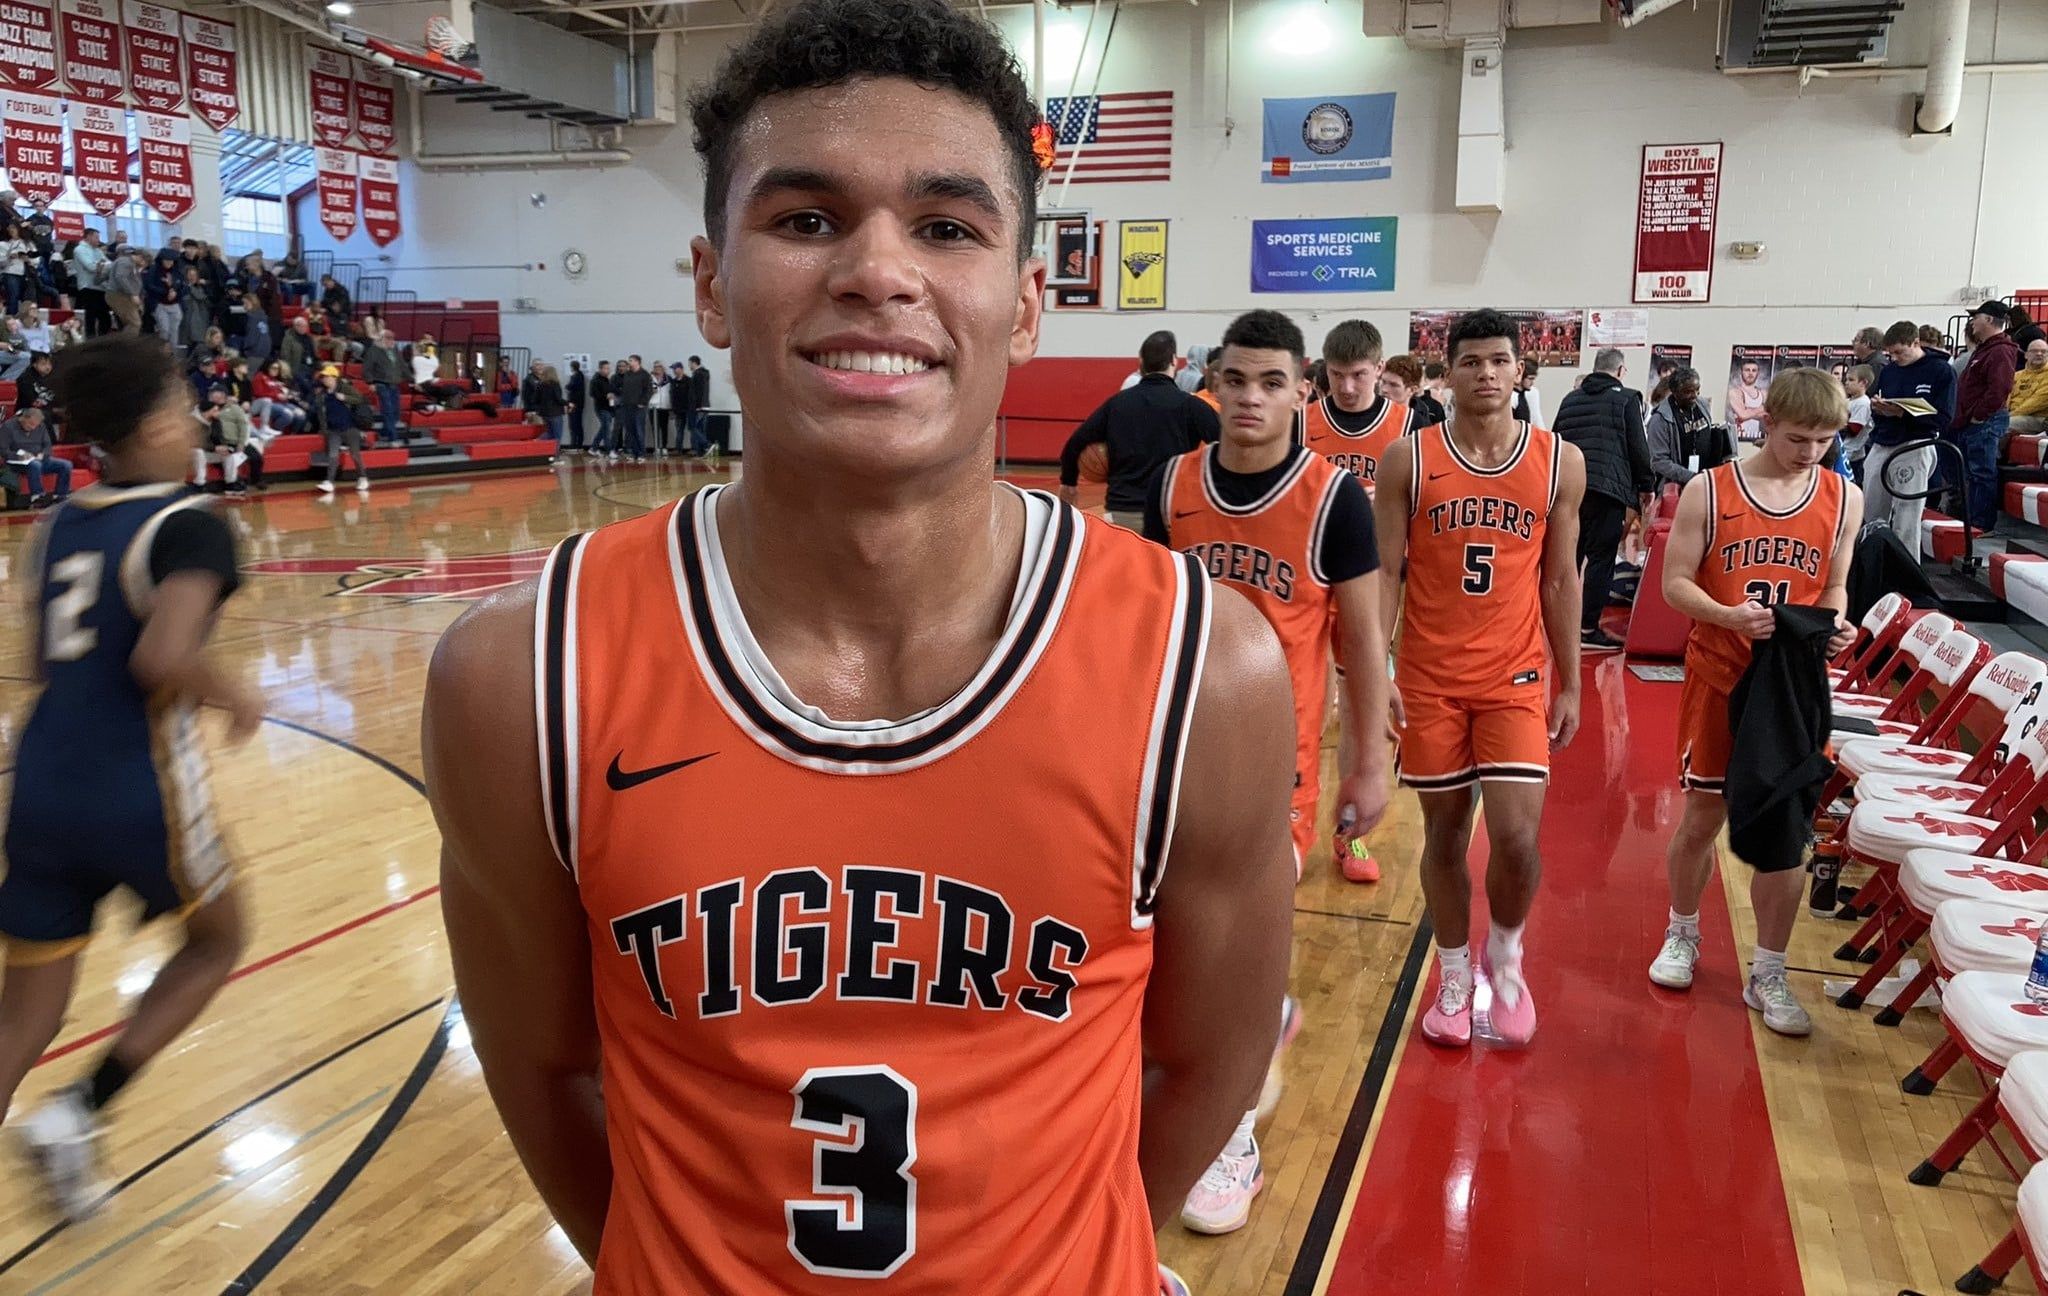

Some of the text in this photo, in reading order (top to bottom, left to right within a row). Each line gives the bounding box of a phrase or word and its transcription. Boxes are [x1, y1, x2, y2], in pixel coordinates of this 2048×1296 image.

[71, 20, 111, 39] CLASS A
[78, 38, 109, 61] STATE
[132, 34, 175, 54] CLASS AA
[140, 53, 172, 73] STATE
[193, 51, 221, 66] CLASS
[67, 61, 122, 87] CHAMPION
[198, 68, 228, 87] STATE
[6, 99, 55, 117] FOOTBALL
[4, 125, 34, 142] CLASS
[82, 118, 115, 132] SOCCER
[80, 138, 120, 154] CLASS A
[143, 142, 184, 159] CLASS AA
[1664, 148, 1700, 158] BOYS
[17, 146, 55, 166] STATE
[1647, 157, 1716, 172] WRESTLING
[85, 156, 119, 175] STATE
[149, 159, 183, 178] STATE
[1653, 179, 1676, 187] JUSTIN
[1676, 178, 1697, 187] SMITH
[1653, 187, 1669, 195] ALEX
[1669, 187, 1686, 195] PECK
[1651, 209, 1672, 217] LOGAN
[1672, 208, 1690, 216] KASS
[1267, 232, 1382, 246] SPORTS MEDICINE
[1293, 245, 1353, 257] SERVICES
[1267, 270, 1299, 278] PROVIDED
[1337, 266, 1378, 279] TRIA
[1658, 276, 1686, 289] 100
[1651, 289, 1692, 298] WIN CLUB
[1428, 496, 1537, 541] TIGERS
[1720, 535, 1822, 579] TIGERS
[1462, 543, 1496, 596] 5
[47, 549, 105, 662] 2
[1986, 663, 2006, 686] Red
[1815, 863, 1831, 880] G
[609, 864, 1090, 1024] TIGERS
[784, 1063, 918, 1279] 3
